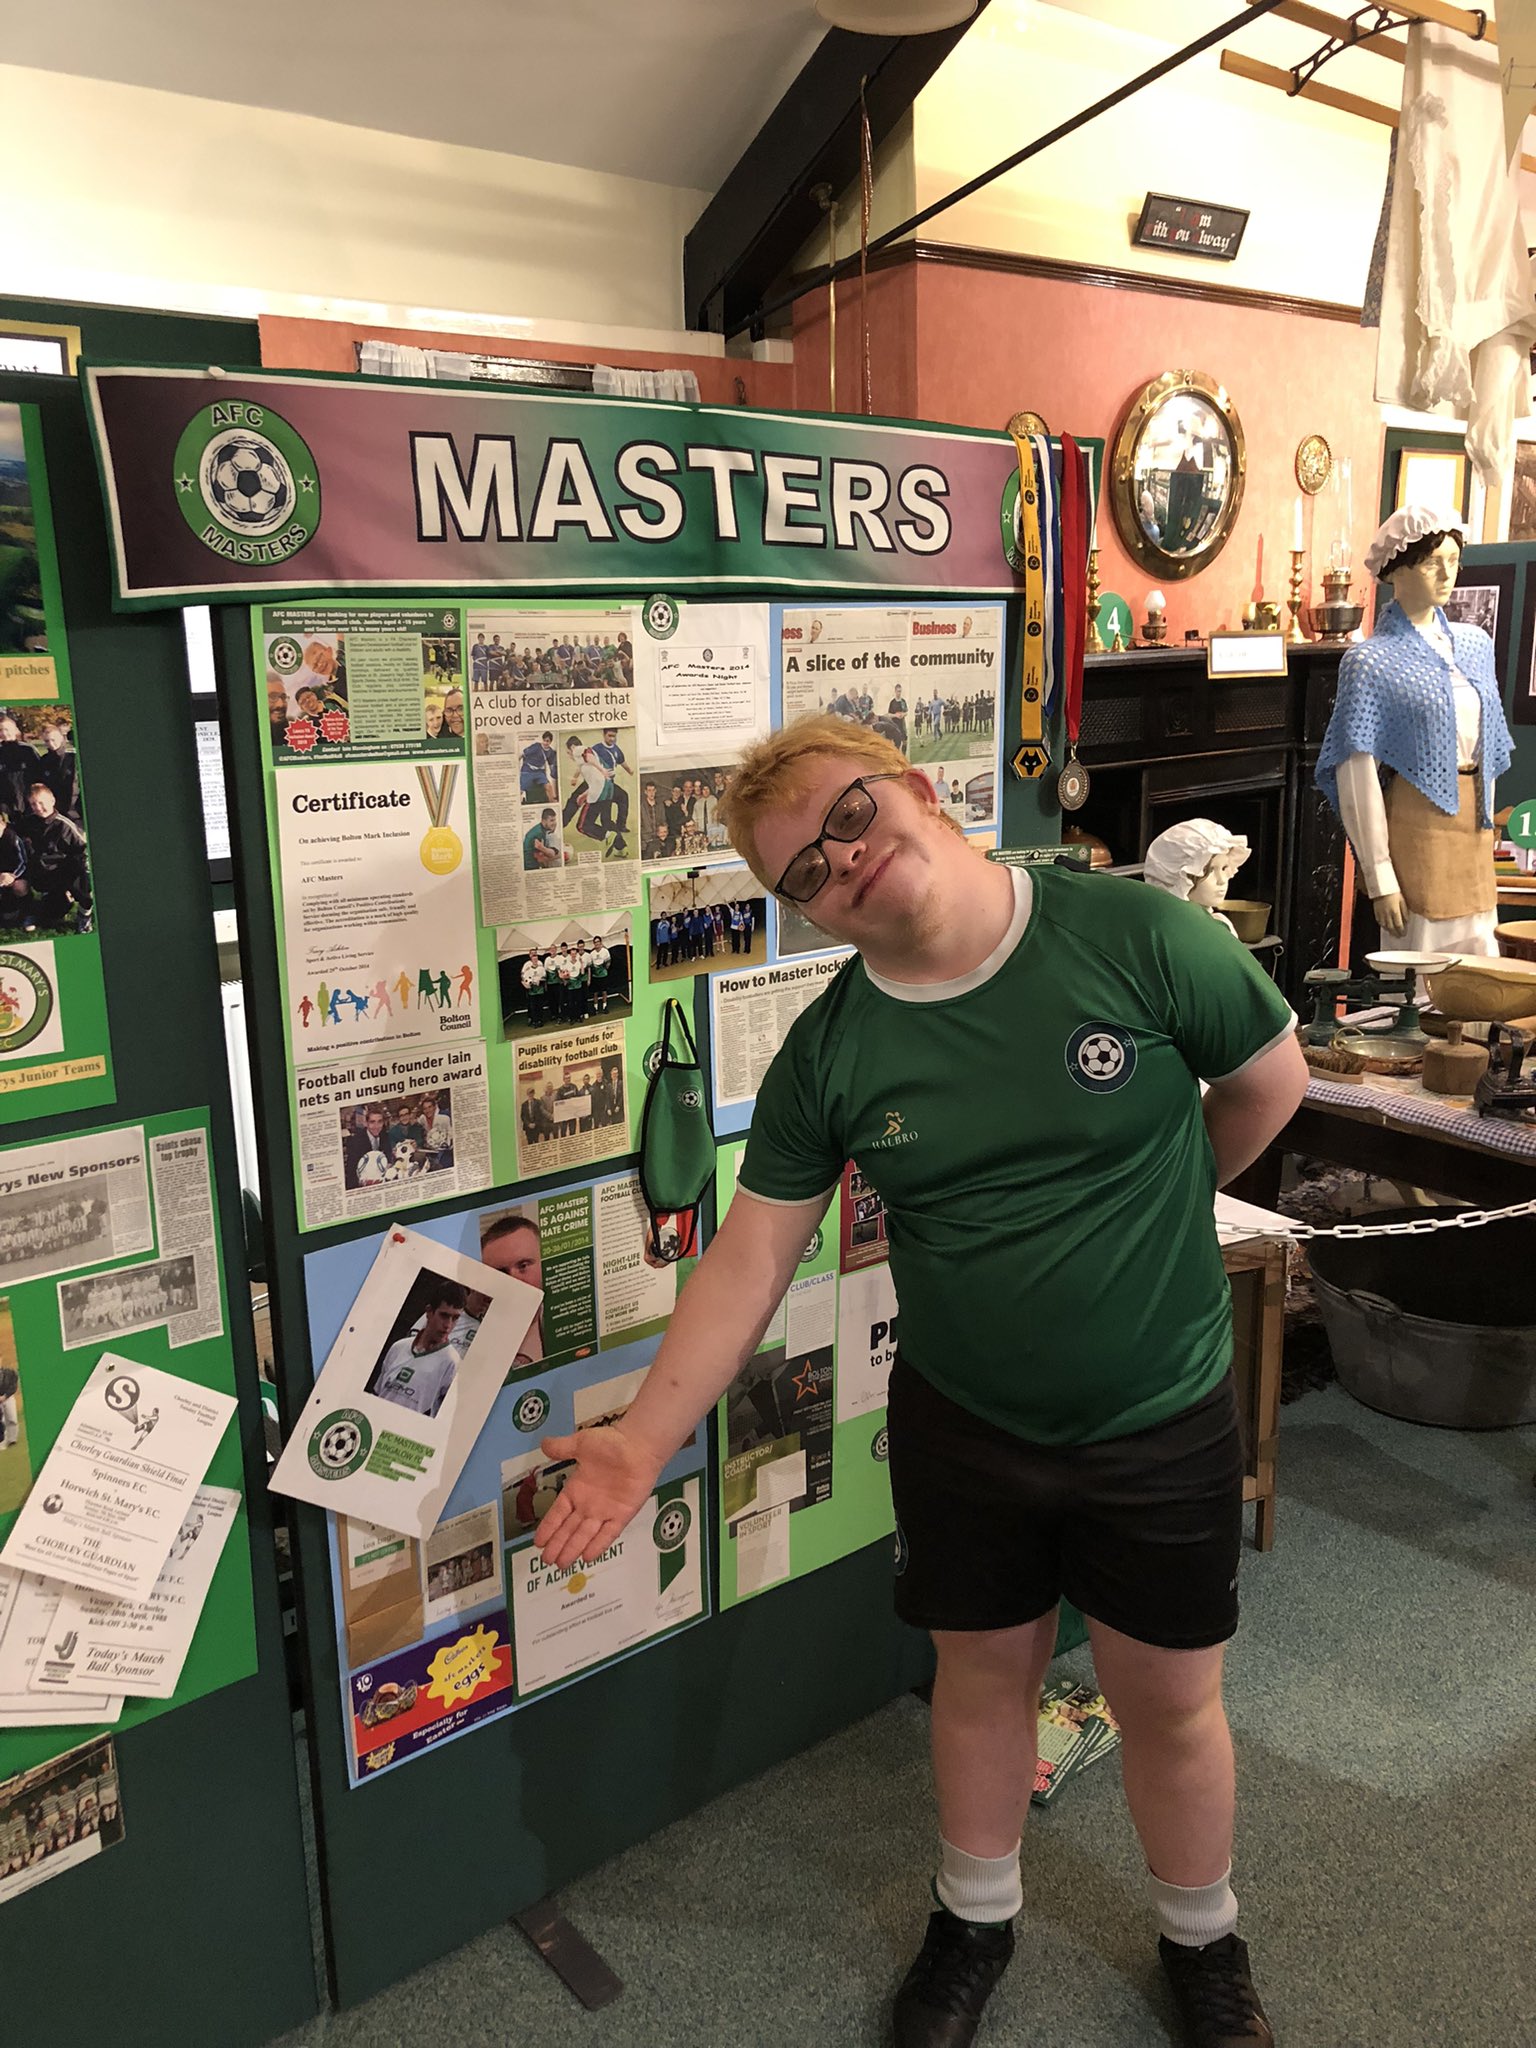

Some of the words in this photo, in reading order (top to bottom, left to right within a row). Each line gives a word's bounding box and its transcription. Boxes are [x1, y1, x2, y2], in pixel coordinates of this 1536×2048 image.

[211, 403, 264, 427] AFC
[408, 431, 952, 555] MASTERS
[201, 524, 307, 562] MASTERS
[913, 621, 957, 635] Business
[1106, 607, 1120, 634] 4
[5, 665, 50, 678] pitches
[786, 656, 800, 673] A
[806, 654, 845, 672] slice
[852, 653, 869, 669] of
[874, 652, 901, 669] the
[911, 649, 994, 667] community
[474, 697, 484, 709] A
[488, 695, 517, 709] club
[522, 694, 542, 708] for
[546, 693, 600, 707] disabled
[605, 692, 630, 705] that
[474, 712, 522, 730] proved
[527, 716, 535, 725] a
[539, 711, 584, 724] Master
[589, 709, 628, 722] stroke
[292, 790, 411, 813] Certificate
[311, 835, 341, 845] achieving
[342, 834, 362, 842] Bolton
[363, 832, 381, 840] Mark
[318, 874, 343, 882] Masters
[720, 979, 750, 993] How
[752, 975, 766, 988] to
[769, 967, 813, 985] Master
[816, 958, 848, 975] lockd
[439, 1014, 471, 1024] Bolton
[440, 1021, 471, 1032] Council
[307, 1044, 329, 1052] Making
[336, 1041, 359, 1049] positive
[403, 1031, 421, 1039] Bolton
[518, 1042, 548, 1058] Pupils
[551, 1040, 573, 1051] raise
[575, 1034, 600, 1048] funds
[602, 1030, 614, 1041] for
[519, 1056, 562, 1072] disability
[565, 1048, 599, 1065] football
[601, 1042, 618, 1055] club
[19, 1070, 58, 1084] Junior
[62, 1061, 101, 1076] Teams
[298, 1069, 355, 1091] Football
[360, 1064, 388, 1080] club
[391, 1057, 444, 1075] founder
[448, 1051, 471, 1066] Iain
[299, 1093, 330, 1108] nets
[334, 1089, 351, 1102] an
[356, 1080, 406, 1099] unsung
[409, 1073, 439, 1089] hero
[442, 1064, 482, 1082] award
[156, 1140, 179, 1152] Saints
[180, 1136, 202, 1147] chase
[872, 1130, 919, 1150] HALBRO
[174, 1147, 198, 1160] trophy
[27, 1168, 64, 1185] New
[69, 1153, 141, 1177] Sponsors
[601, 1185, 616, 1195] AFC
[617, 1180, 640, 1192] MASTE
[601, 1191, 631, 1203] FOOTBALL
[632, 1187, 643, 1196] CLU
[540, 1205, 555, 1215] AFC
[557, 1196, 588, 1210] MASTERS
[540, 1217, 549, 1227] IS
[551, 1206, 589, 1224] AGAINST
[541, 1226, 562, 1239] HATE
[563, 1218, 589, 1233] CRIME
[603, 1252, 640, 1270] NIGHT-LIFE
[603, 1268, 613, 1276] AT
[629, 1261, 640, 1271] BAR
[790, 1273, 834, 1293] CLUB/CLASS
[605, 1303, 630, 1315] CONTACT
[870, 1354, 882, 1367] to
[398, 1435, 426, 1454] MASTERS
[70, 1439, 102, 1458] Chorley
[103, 1450, 141, 1472] Guardian
[141, 1463, 166, 1480] Shield
[164, 1470, 187, 1486] Final
[724, 1444, 773, 1472] INSTRUCTOR/
[92, 1468, 130, 1489] Spinners
[725, 1461, 752, 1479] COACH
[60, 1479, 99, 1500] Horwich
[116, 1495, 144, 1514] Mary's
[739, 1508, 782, 1530] VOLUNTEER
[739, 1530, 746, 1539] IN
[747, 1519, 772, 1536] SPORT
[82, 1536, 102, 1548] THE
[35, 1535, 82, 1558] CHORLEY
[83, 1548, 136, 1572] GUARDIAN
[527, 1579, 541, 1593] OF
[545, 1542, 625, 1586] ACHIEVEMENT
[561, 1595, 586, 1610] Awarded
[86, 1647, 128, 1663] Today's
[132, 1651, 165, 1665] Match
[86, 1661, 110, 1673] Ball
[112, 1663, 155, 1677] Sponsor
[453, 1662, 486, 1691] eggs
[412, 1715, 454, 1740] Especially
[455, 1708, 468, 1718] for
